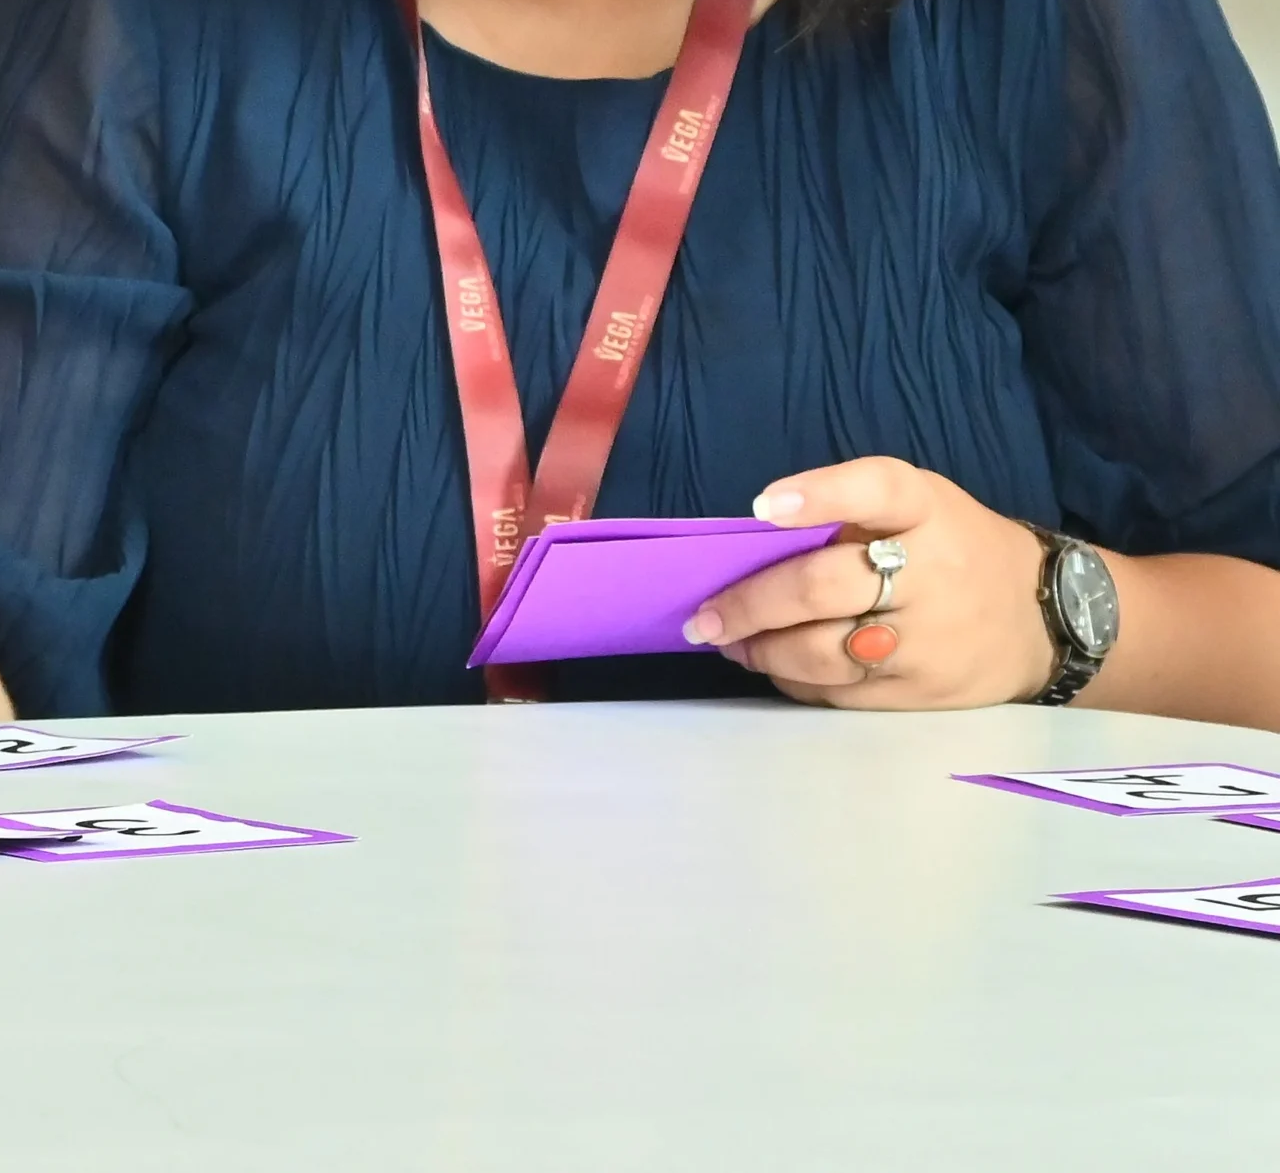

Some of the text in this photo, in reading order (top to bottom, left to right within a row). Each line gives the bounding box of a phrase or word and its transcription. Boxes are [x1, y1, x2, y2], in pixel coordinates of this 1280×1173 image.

[661, 108, 704, 163] VEGA
[458, 276, 486, 332] VEGA
[593, 311, 638, 361] VEGA
[490, 508, 519, 567] VEGA
[59, 819, 201, 842] 3
